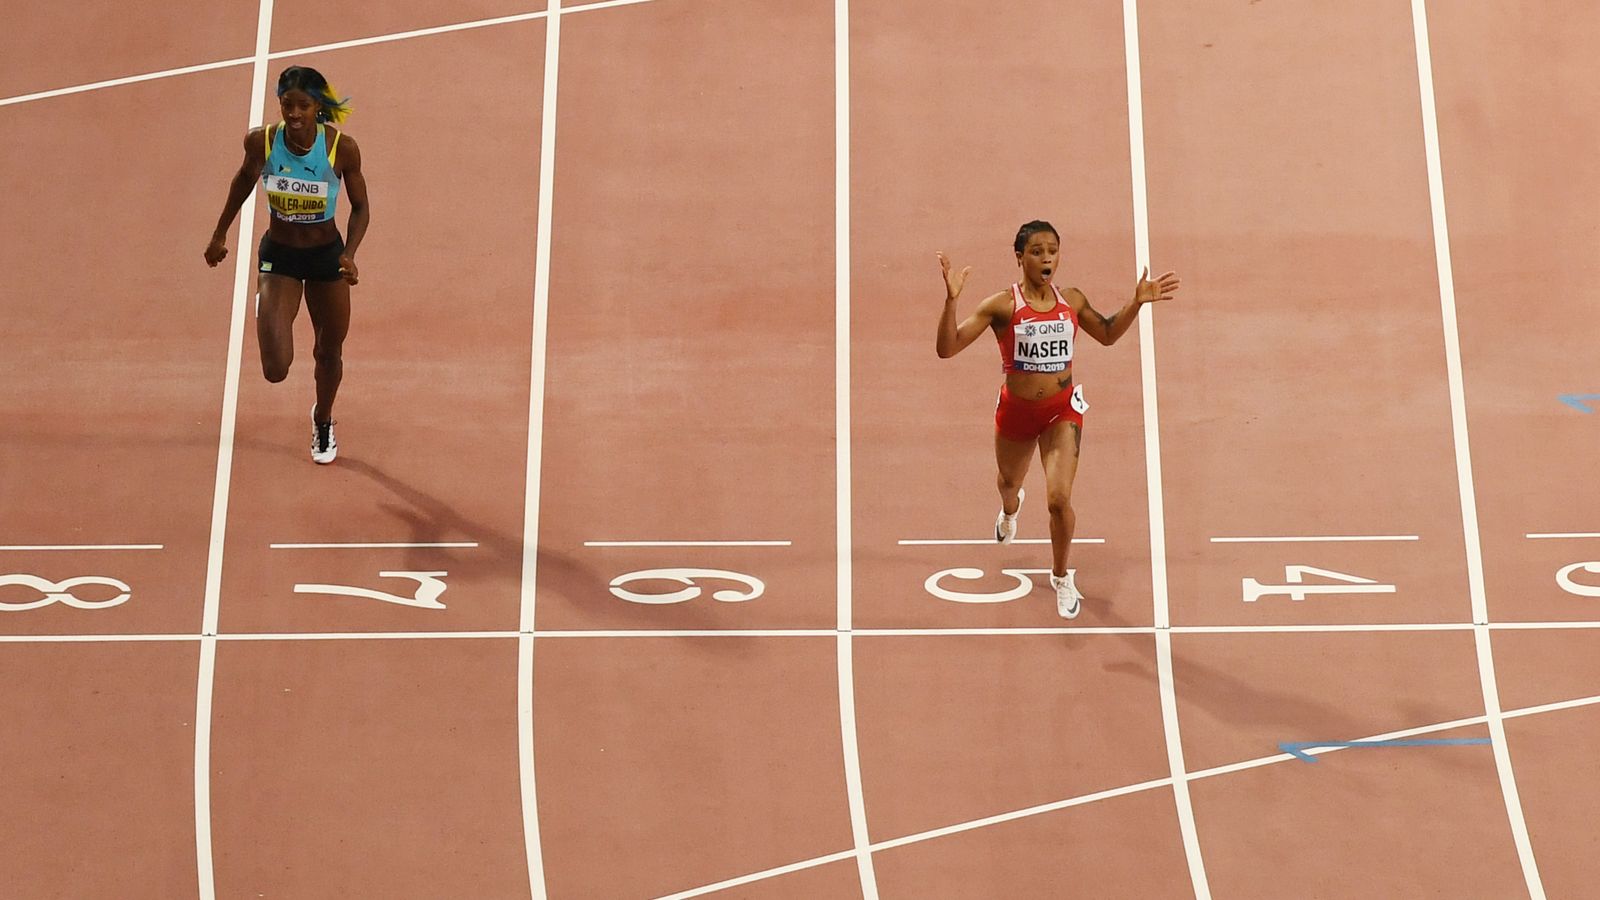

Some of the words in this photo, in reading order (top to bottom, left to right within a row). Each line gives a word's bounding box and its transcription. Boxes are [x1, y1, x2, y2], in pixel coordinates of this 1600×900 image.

[291, 181, 319, 194] QNB
[1038, 323, 1065, 335] QNB
[1018, 340, 1068, 358] NASER
[1023, 362, 1066, 372] DOHA2019
[0, 574, 131, 611] 8
[294, 571, 448, 609] 7
[609, 568, 765, 604] 6
[924, 568, 1085, 604] 5
[1242, 565, 1397, 603] 4
